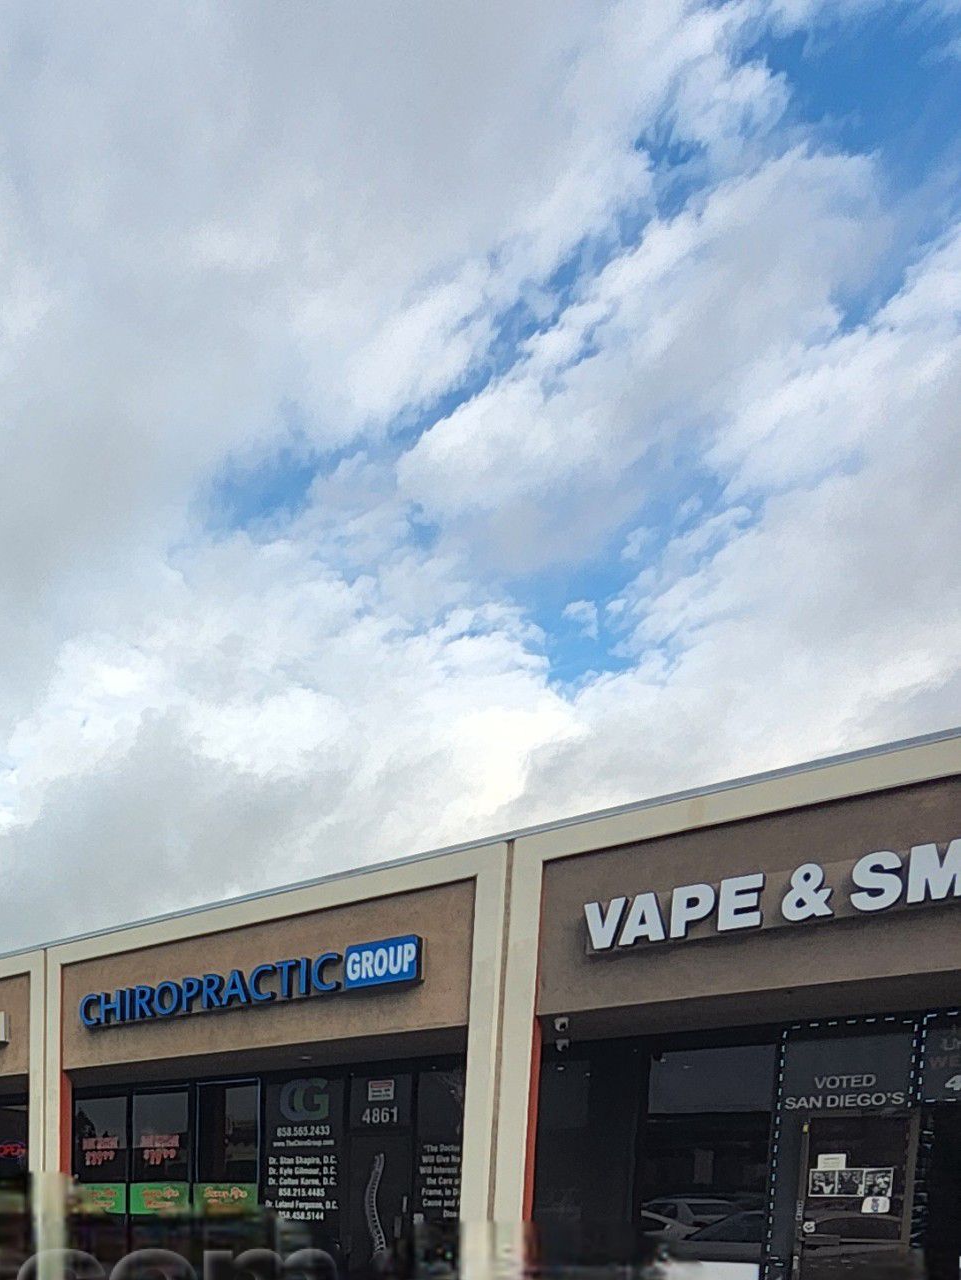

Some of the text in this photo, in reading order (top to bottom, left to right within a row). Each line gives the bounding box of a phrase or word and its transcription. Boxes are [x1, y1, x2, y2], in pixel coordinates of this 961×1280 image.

[584, 872, 764, 950] VAPE
[781, 863, 833, 922] &
[346, 943, 417, 981] GROUP
[79, 952, 340, 1027] CHIROPRACTIC
[814, 1074, 877, 1090] VOTED
[785, 1091, 905, 1110] SAN DIEGO'S
[361, 1106, 398, 1124] 4861
